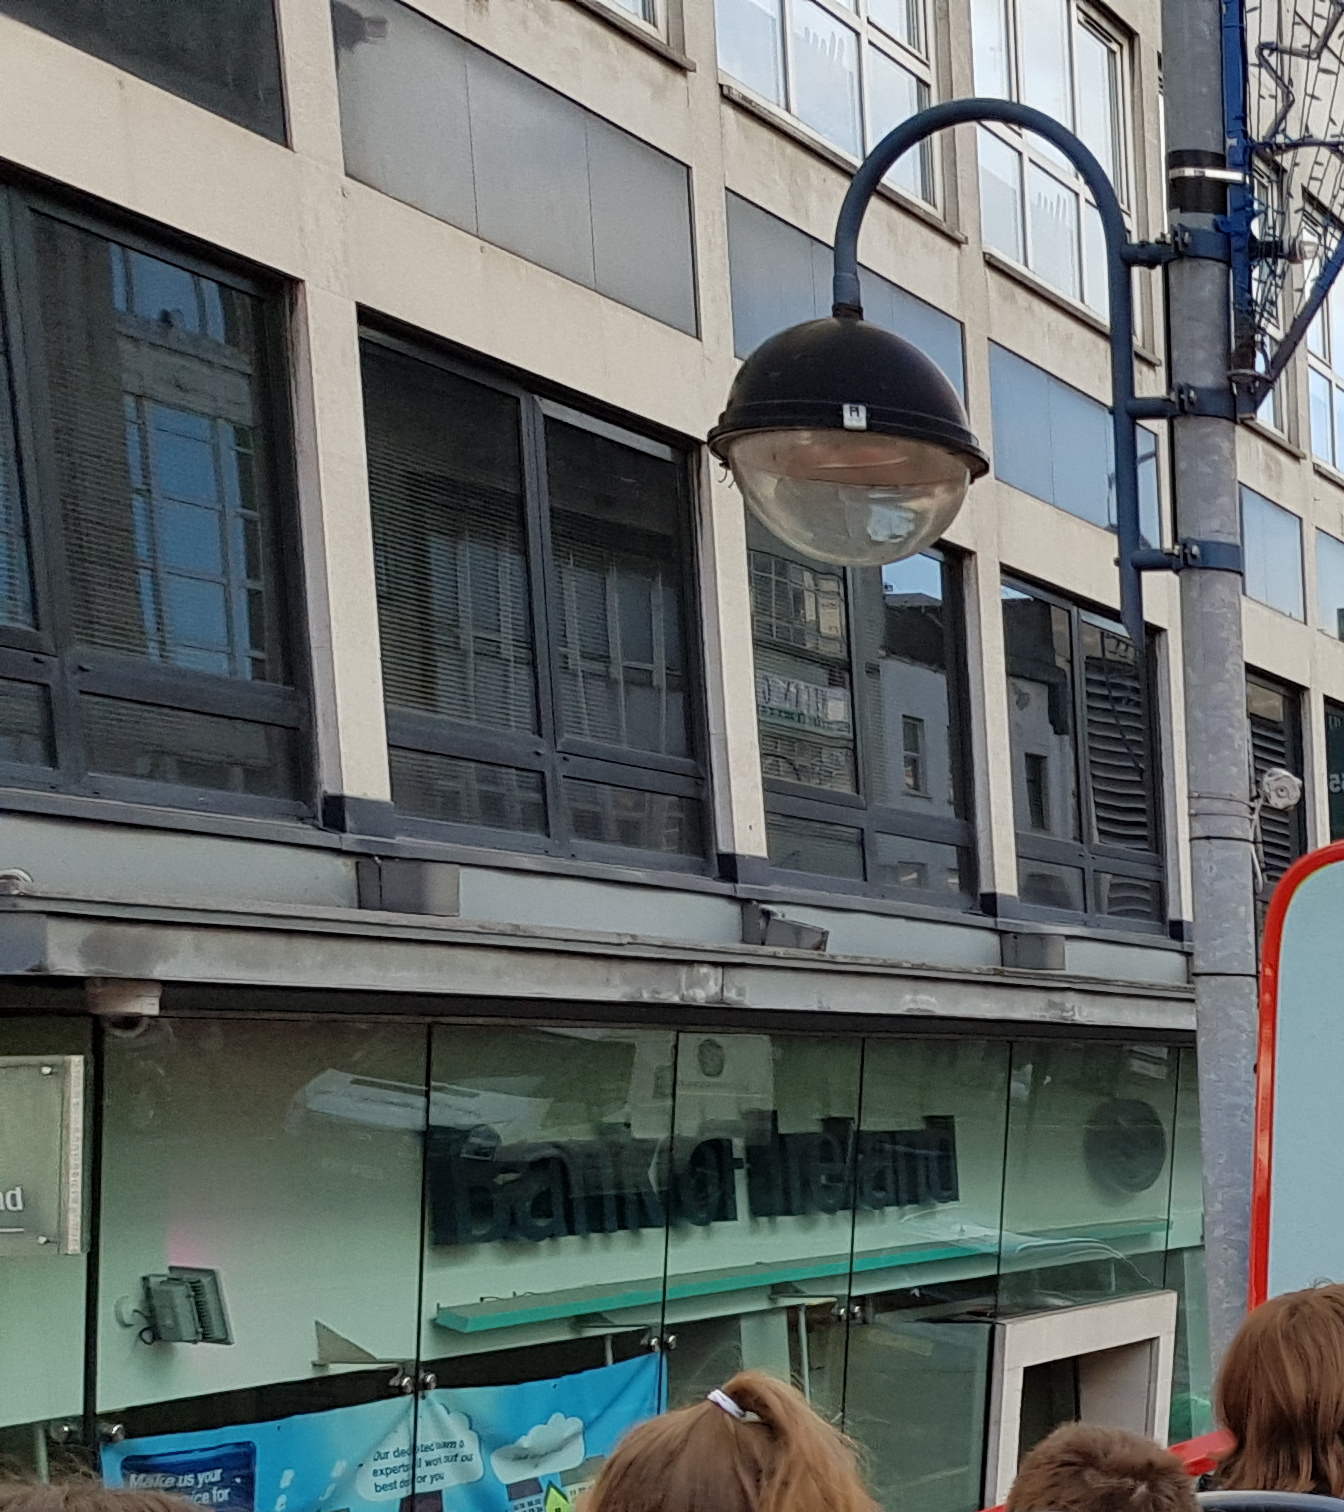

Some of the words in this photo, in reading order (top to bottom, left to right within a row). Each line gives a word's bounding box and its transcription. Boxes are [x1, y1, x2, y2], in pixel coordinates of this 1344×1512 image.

[129, 1473, 175, 1488] Make
[177, 1473, 194, 1487] us
[198, 1468, 223, 1487] your
[212, 1487, 230, 1503] for
